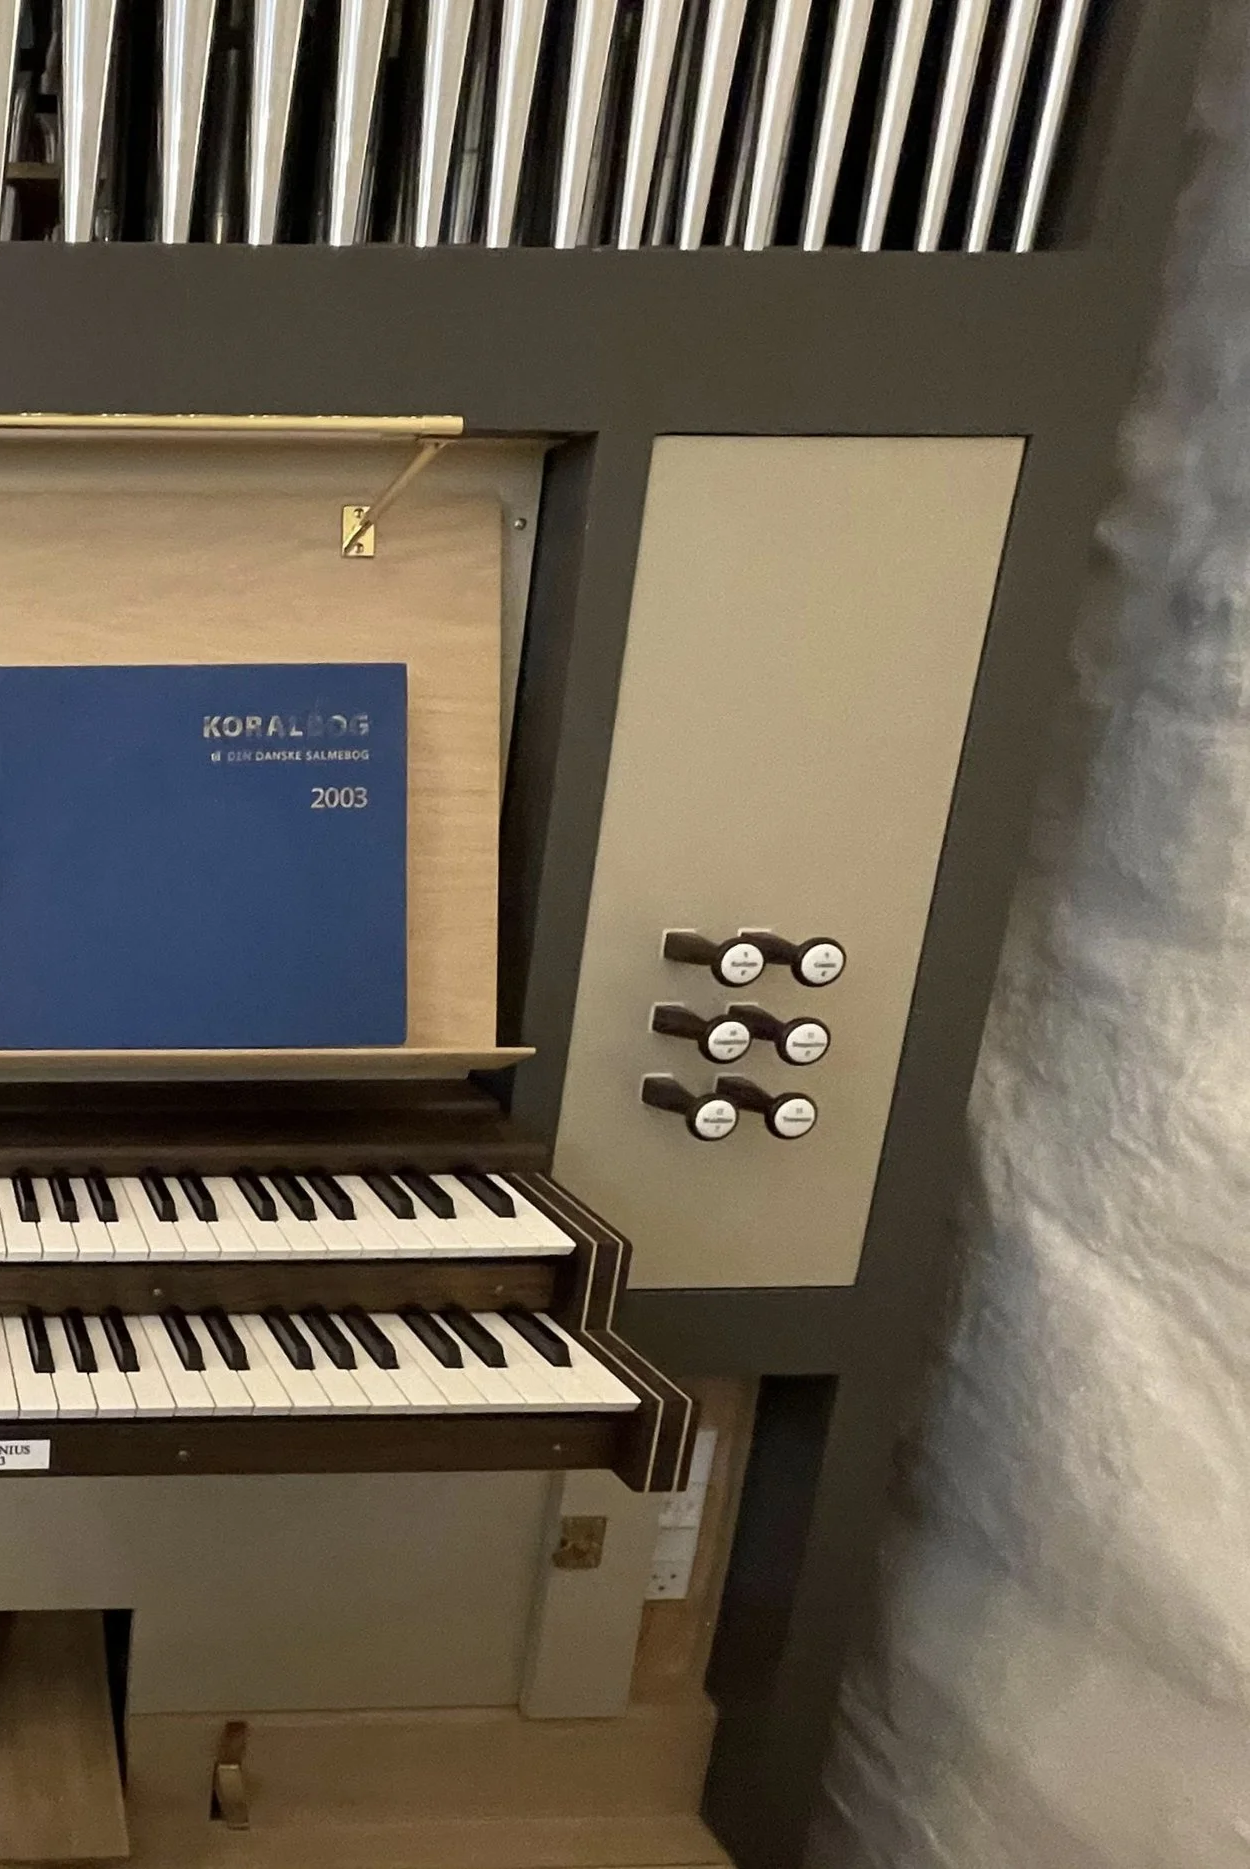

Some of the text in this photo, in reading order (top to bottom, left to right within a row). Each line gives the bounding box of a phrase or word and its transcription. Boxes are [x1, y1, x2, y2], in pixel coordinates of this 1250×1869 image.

[255, 751, 302, 761] DANSKE
[305, 750, 370, 761] SALMEBOG
[310, 787, 368, 809] 2003
